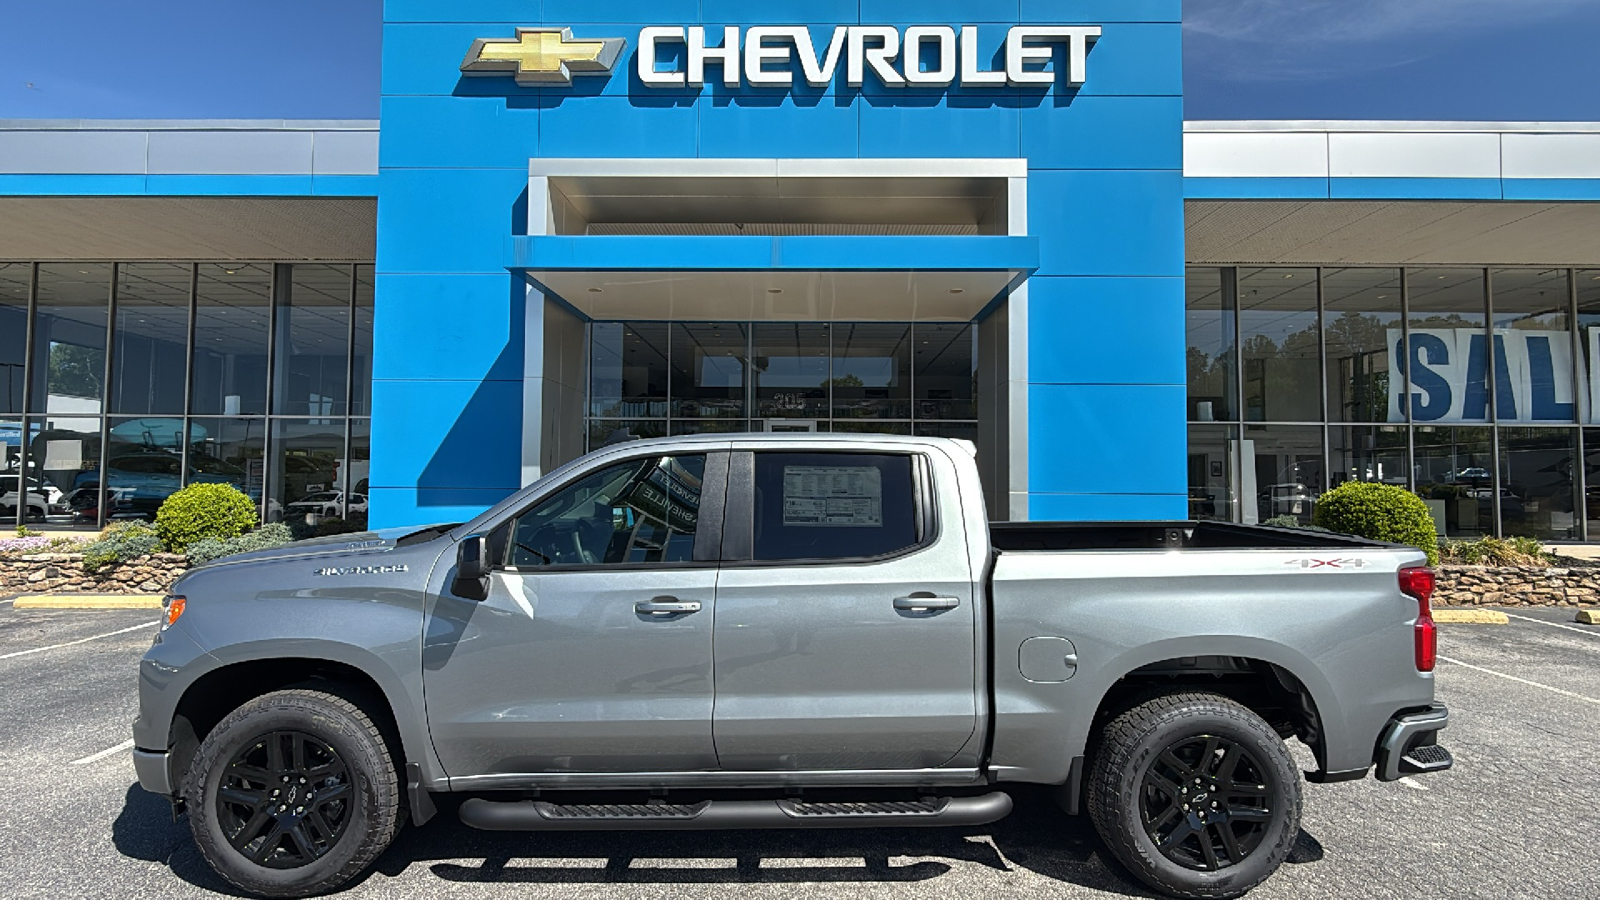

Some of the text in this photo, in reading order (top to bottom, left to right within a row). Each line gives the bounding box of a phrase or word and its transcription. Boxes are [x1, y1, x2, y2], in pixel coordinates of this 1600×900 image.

[637, 26, 1102, 88] CHEVROLET
[774, 392, 807, 409] 205
[1396, 332, 1600, 421] SAL
